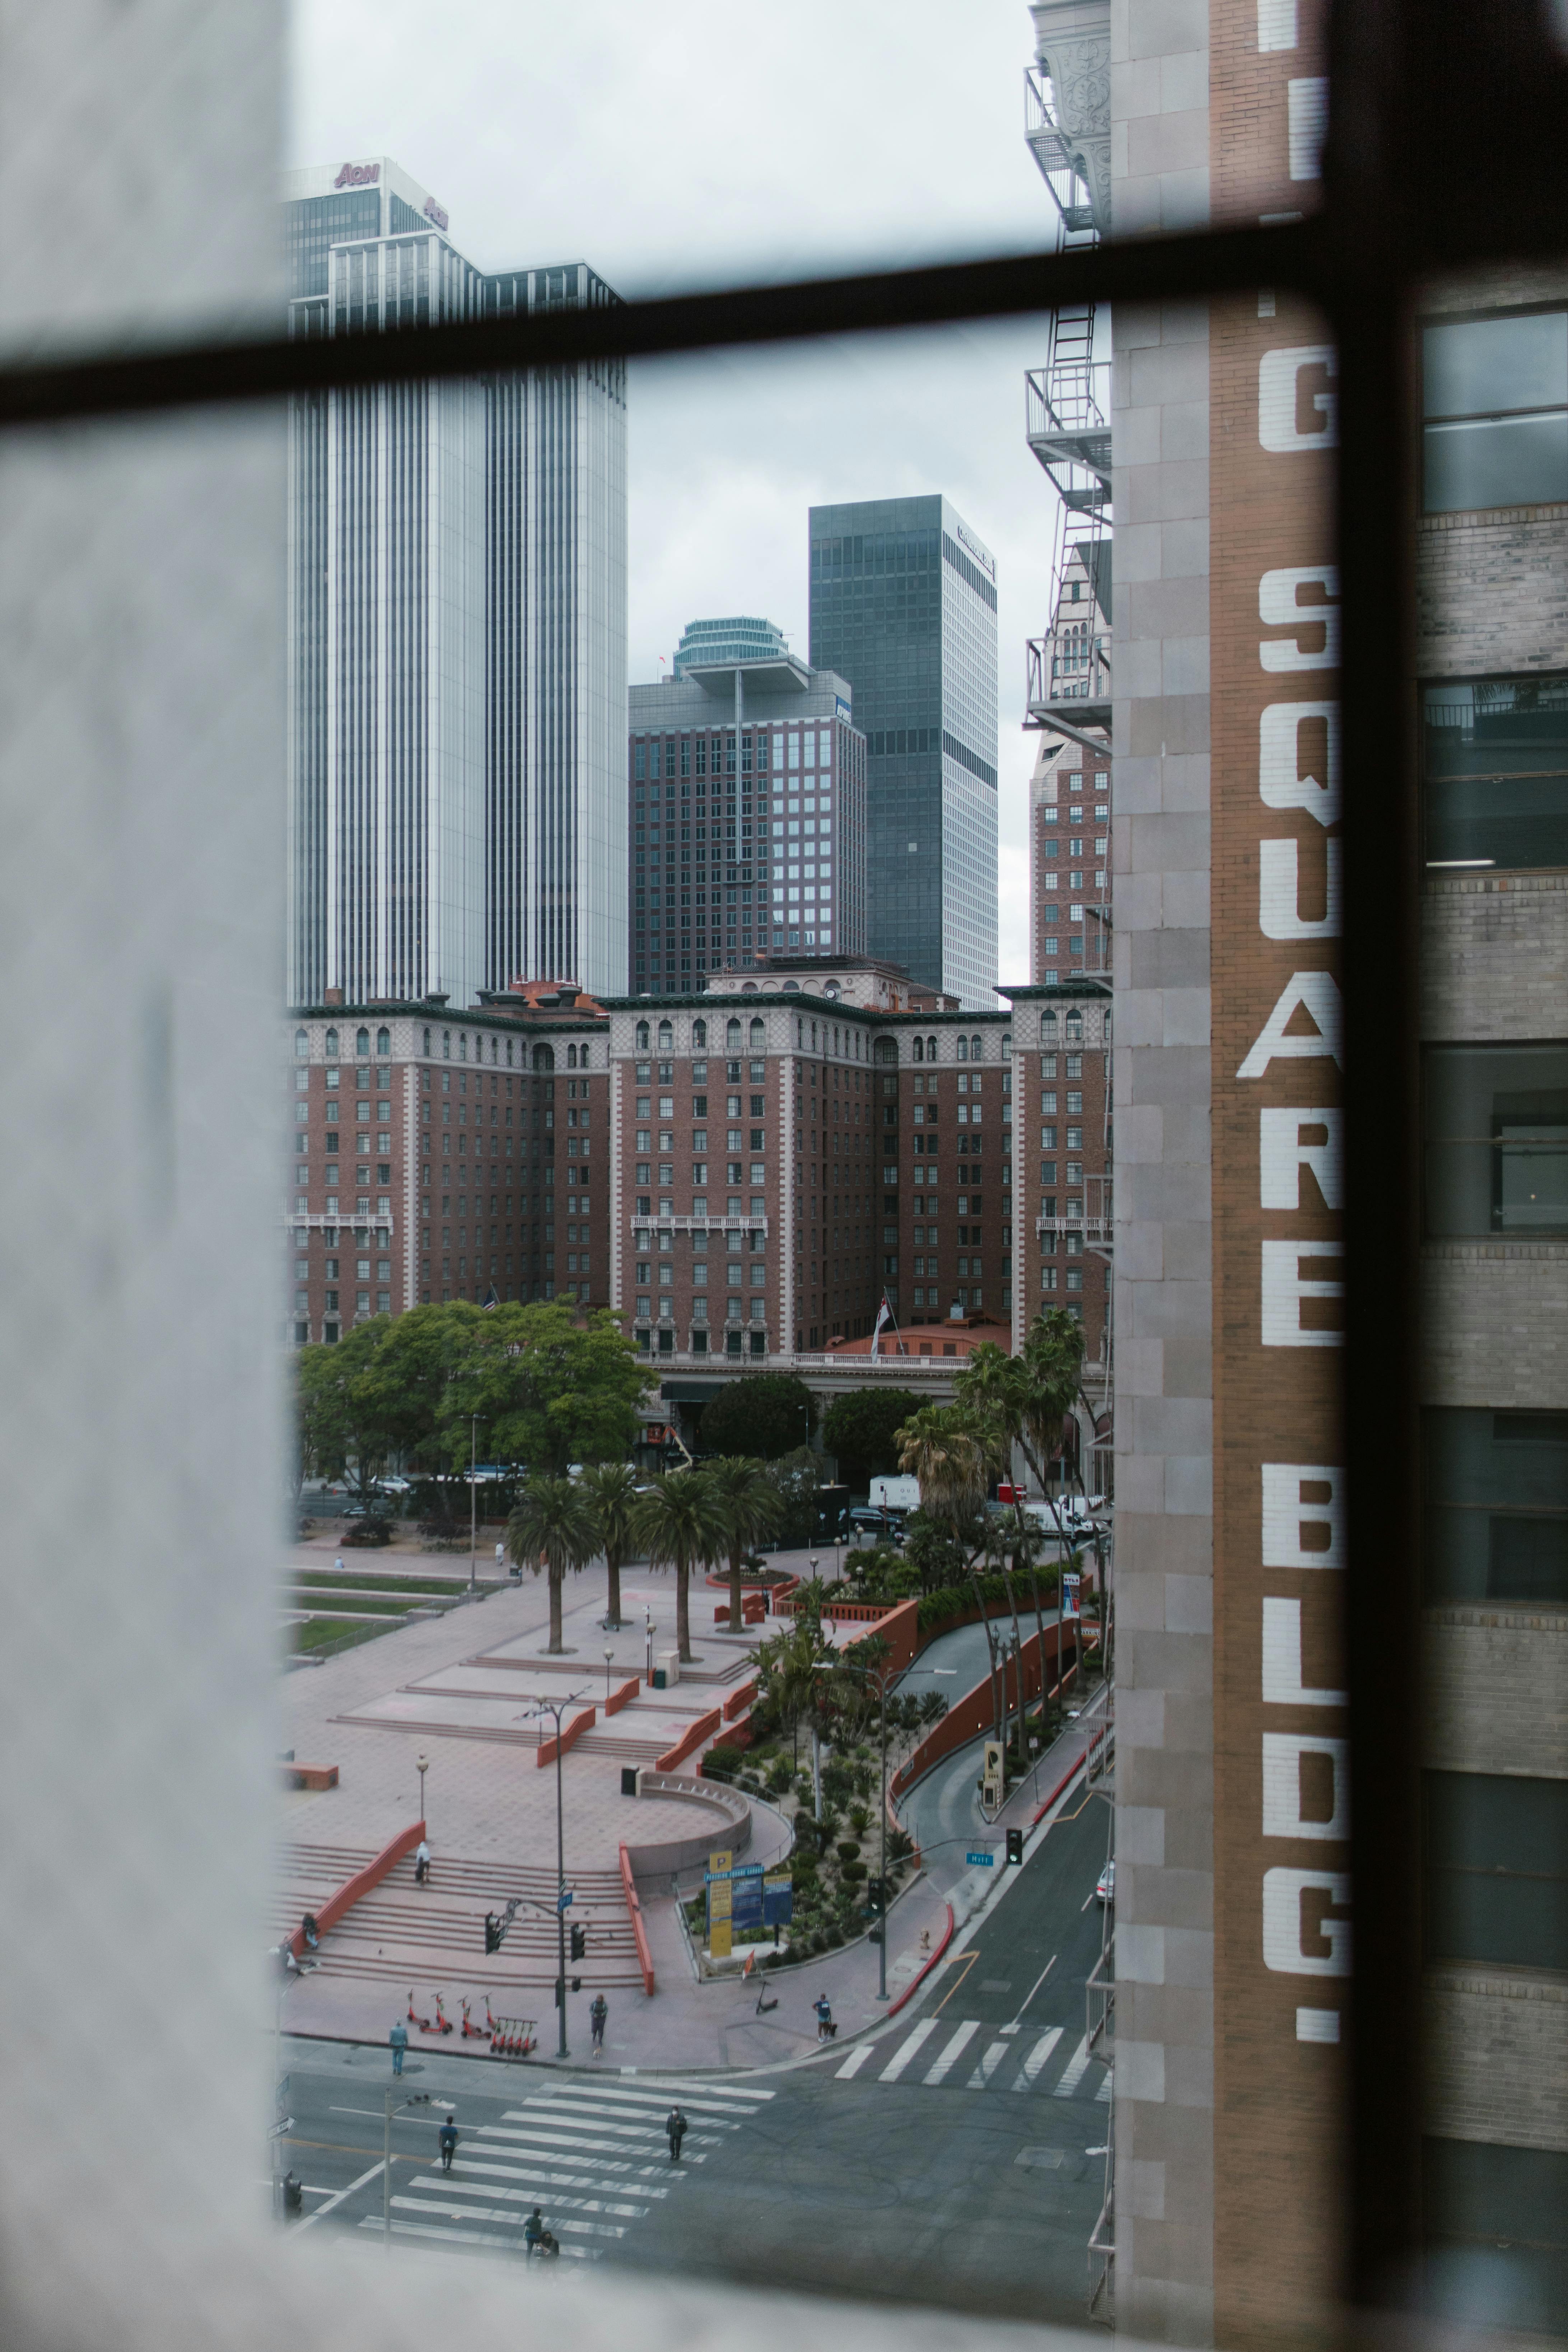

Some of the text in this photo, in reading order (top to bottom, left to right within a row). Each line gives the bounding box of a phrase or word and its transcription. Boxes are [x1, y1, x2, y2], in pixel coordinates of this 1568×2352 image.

[1236, 565, 1343, 1346] SQUARE
[717, 1857, 725, 1868] P
[729, 1869, 745, 1878] SQUARE
